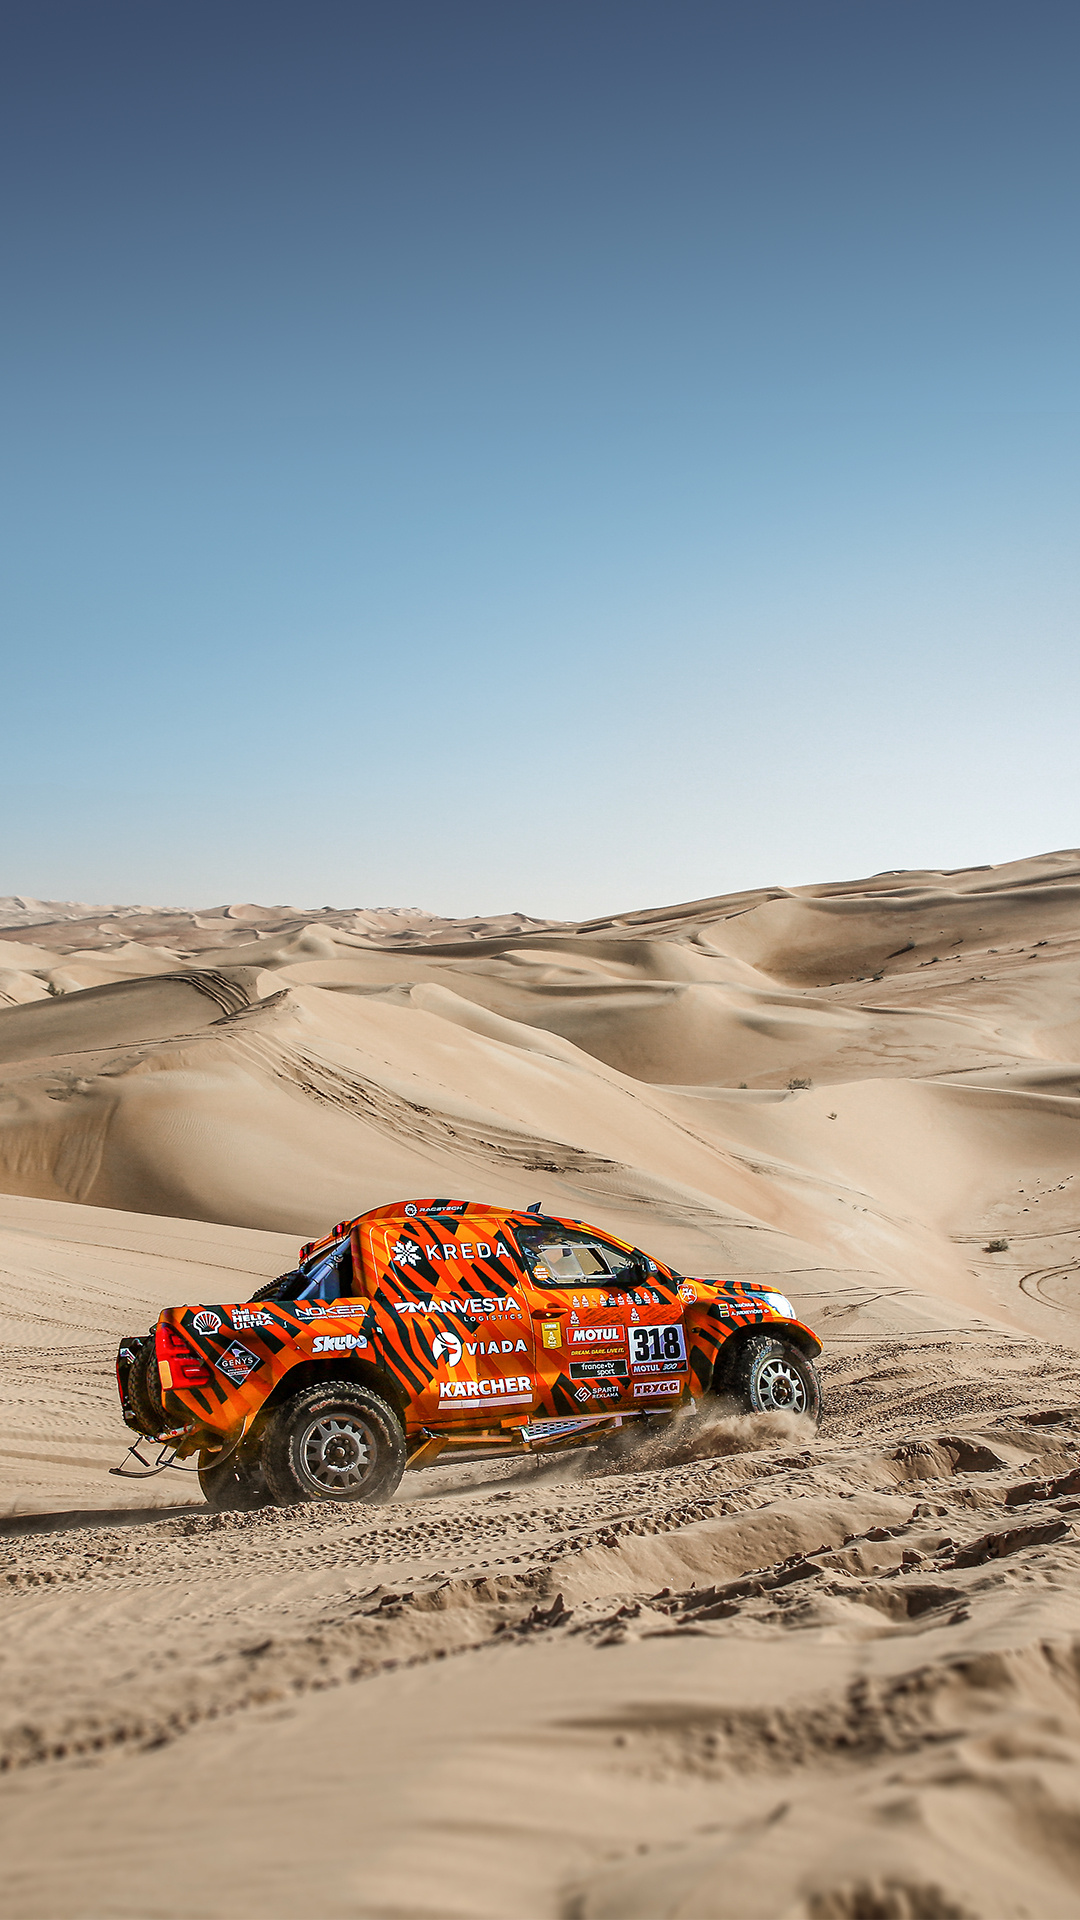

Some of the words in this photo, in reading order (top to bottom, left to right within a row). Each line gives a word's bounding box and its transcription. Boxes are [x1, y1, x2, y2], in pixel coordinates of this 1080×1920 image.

[425, 1242, 510, 1260] KREDA
[408, 1297, 520, 1313] MANVESTA
[231, 1308, 250, 1316] Shell
[232, 1311, 274, 1323] HELIX
[464, 1314, 523, 1322] LOGISTICS
[233, 1319, 275, 1331] ULTRA
[572, 1327, 620, 1342] MOTUL
[466, 1339, 528, 1355] VIADA
[633, 1326, 682, 1361] 318
[221, 1357, 254, 1368] GENYS
[633, 1364, 660, 1373] MOTUL
[596, 1369, 616, 1378] sport
[439, 1376, 533, 1398] KÄRCHER
[592, 1386, 619, 1394] SPARTI
[634, 1382, 678, 1394] TRYGG
